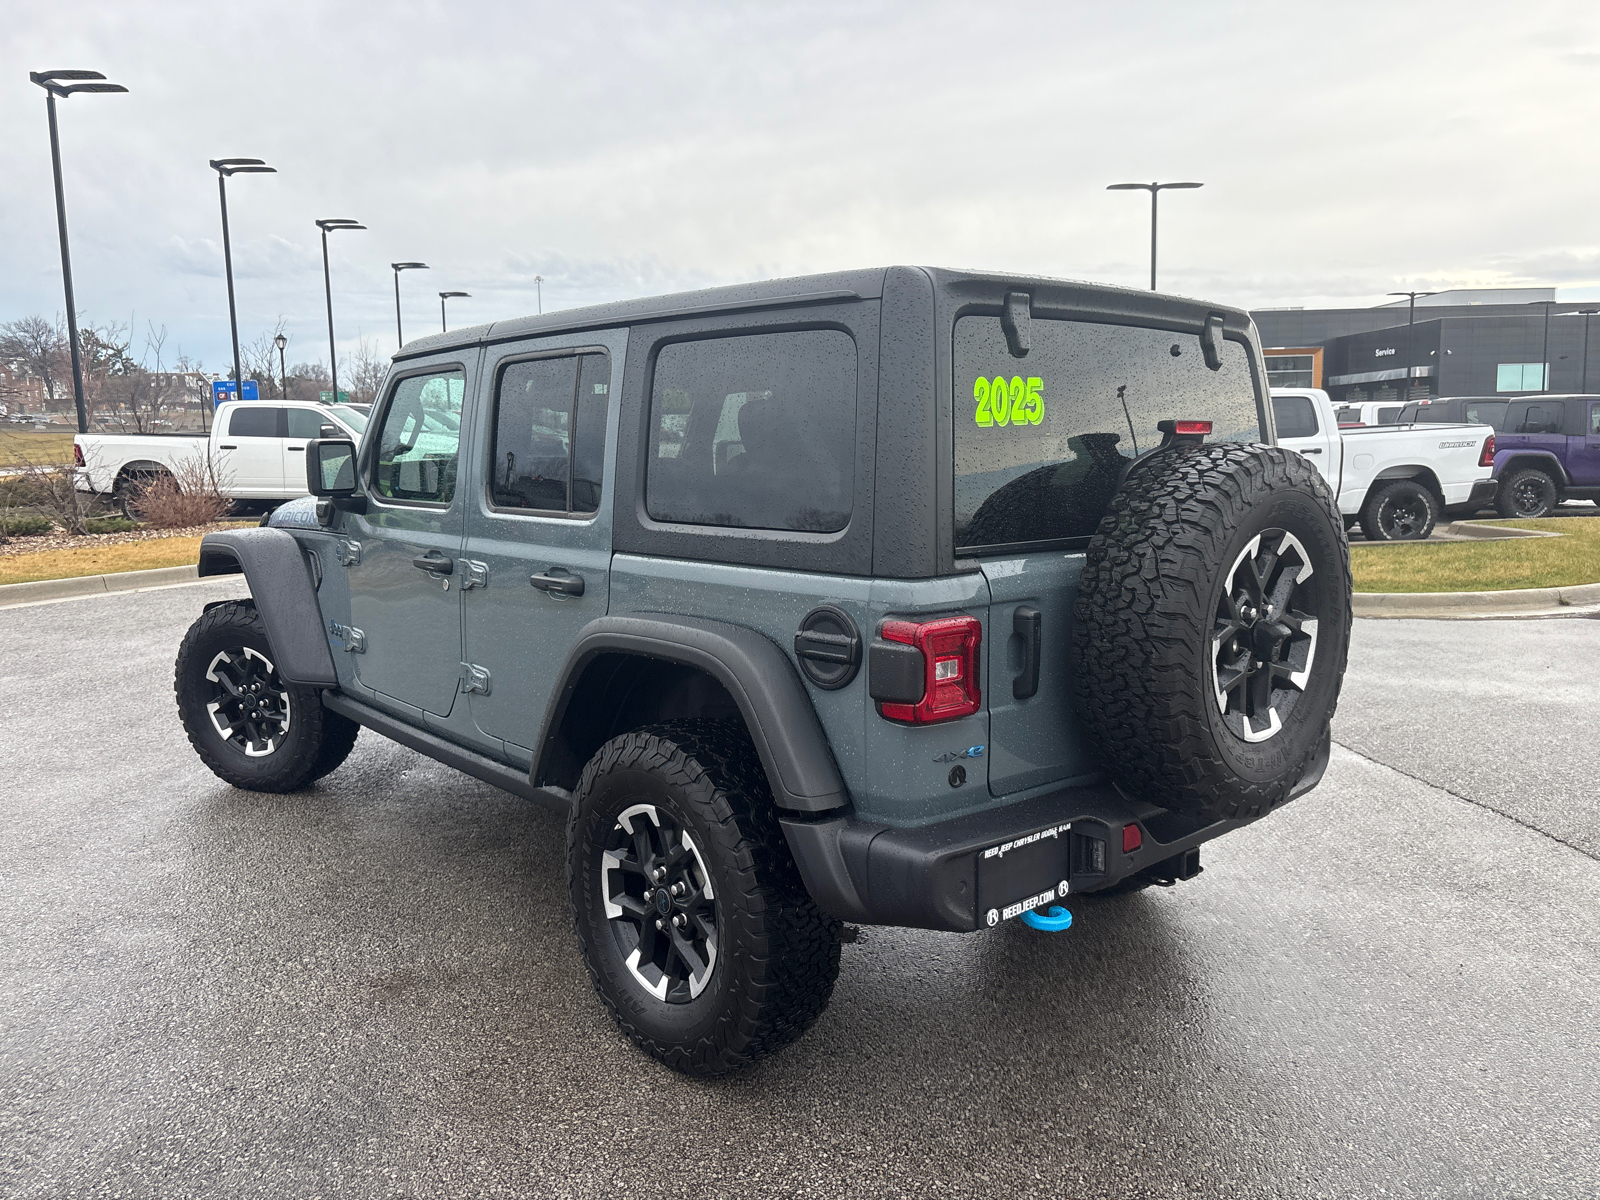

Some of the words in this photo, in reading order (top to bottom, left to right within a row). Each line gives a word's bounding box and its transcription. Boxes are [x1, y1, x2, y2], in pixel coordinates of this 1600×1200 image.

[1375, 347, 1395, 357] Service
[973, 376, 1045, 427] 2025
[984, 847, 999, 858] REED
[1000, 842, 1013, 852] JEEP
[1013, 832, 1041, 848] CHRYSLER
[1041, 827, 1058, 838] DODGE
[1058, 823, 1071, 832] RAM
[1002, 889, 1055, 920] REEDJEEP.COM
